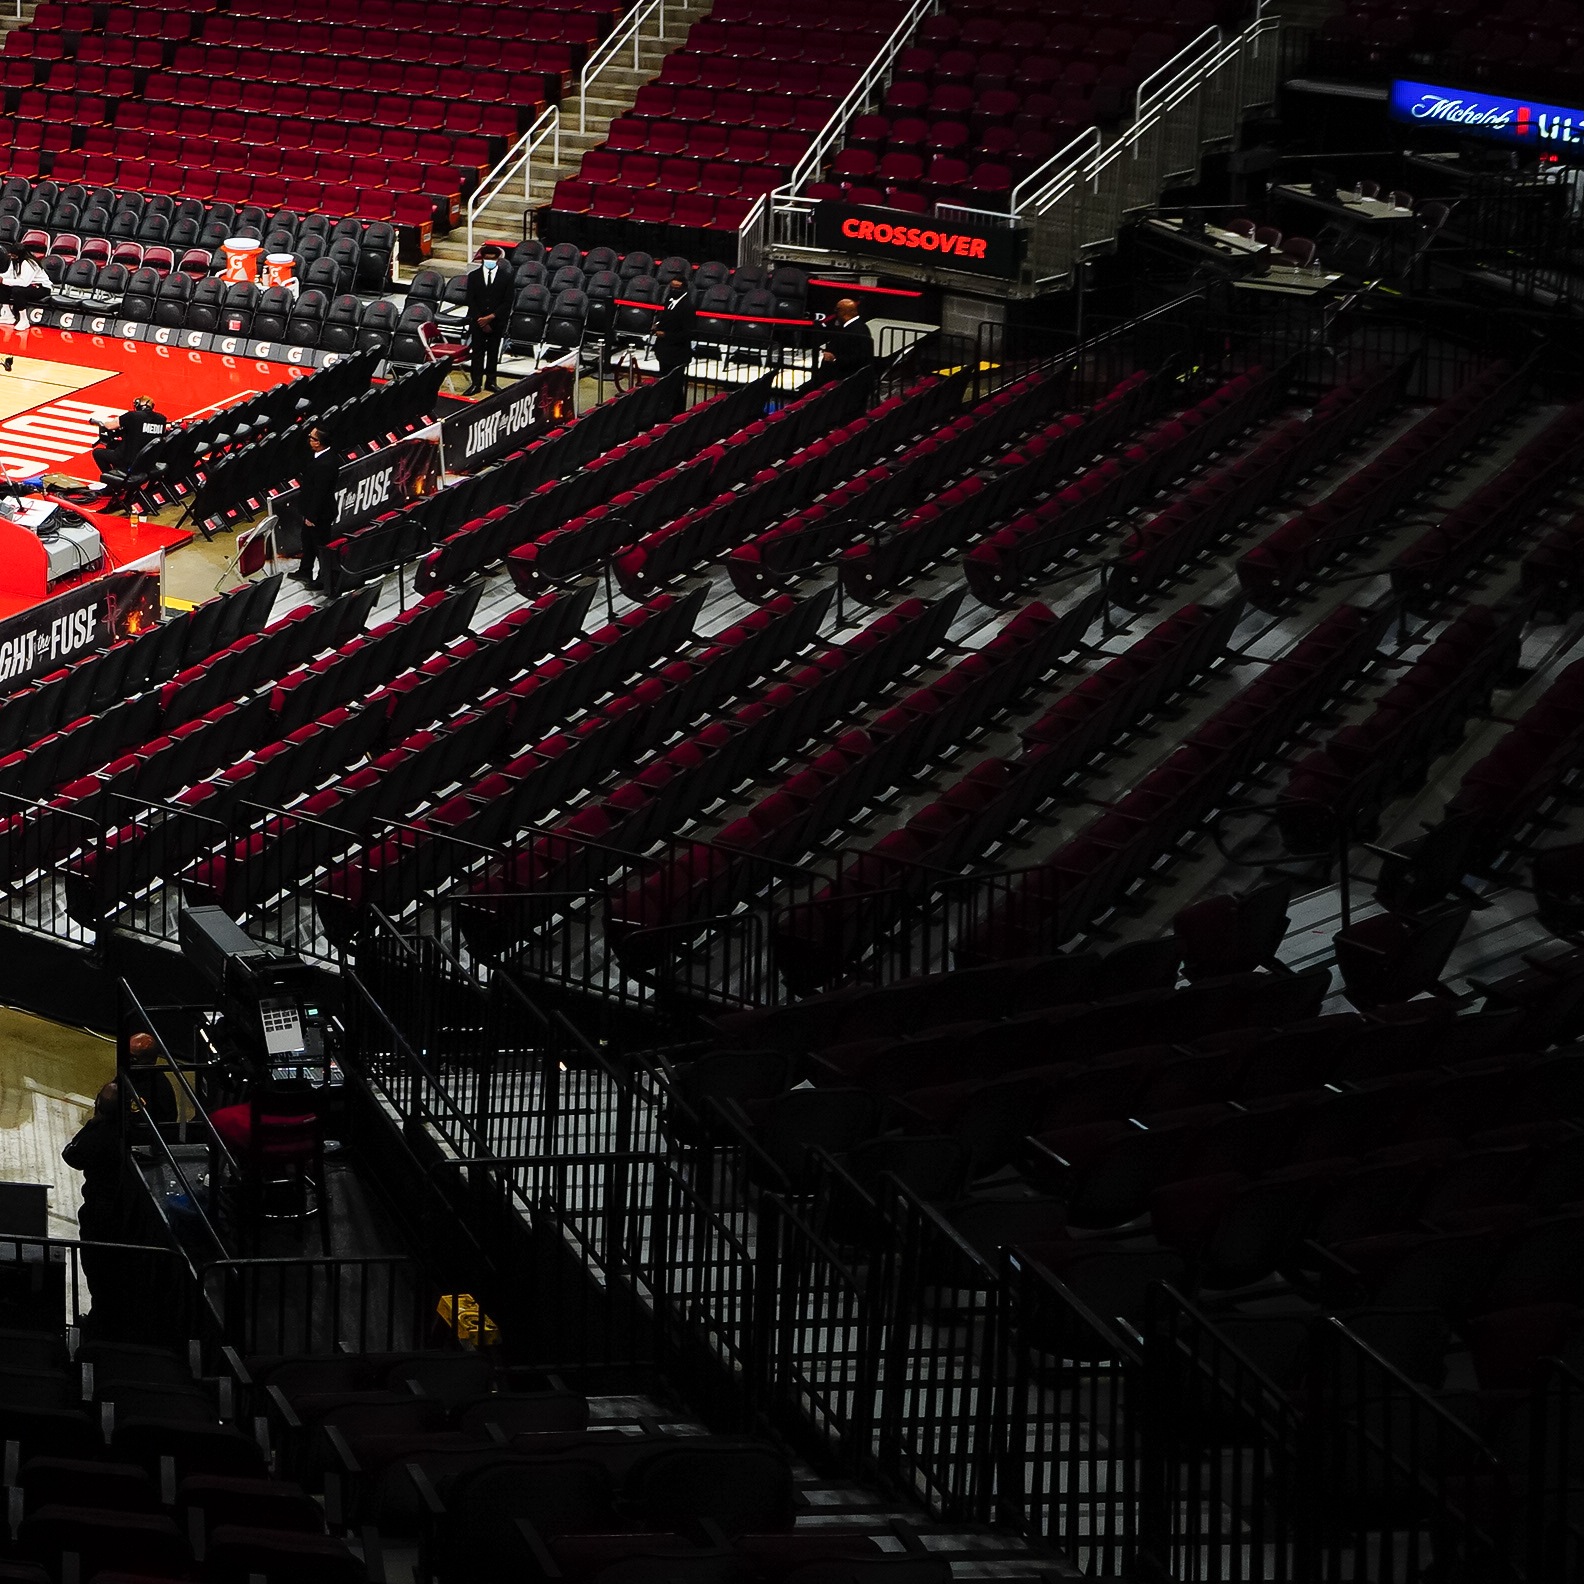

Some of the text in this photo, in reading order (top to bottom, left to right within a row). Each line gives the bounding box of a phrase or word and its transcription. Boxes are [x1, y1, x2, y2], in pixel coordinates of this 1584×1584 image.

[1412, 94, 1514, 129] Michelob
[842, 218, 987, 258] CROSSOVER
[230, 255, 243, 270] G
[269, 267, 279, 279] G
[30, 308, 44, 323] G
[60, 313, 74, 327] G
[91, 317, 105, 332] G
[122, 322, 137, 337] G
[187, 332, 203, 347] G
[221, 337, 237, 353] G
[288, 347, 303, 363] G
[323, 352, 339, 367] G
[466, 409, 501, 458] LIGHT
[506, 391, 538, 435] FUSE
[354, 467, 393, 515] FUSE
[35, 632, 51, 656] the
[50, 603, 97, 661] FUSE
